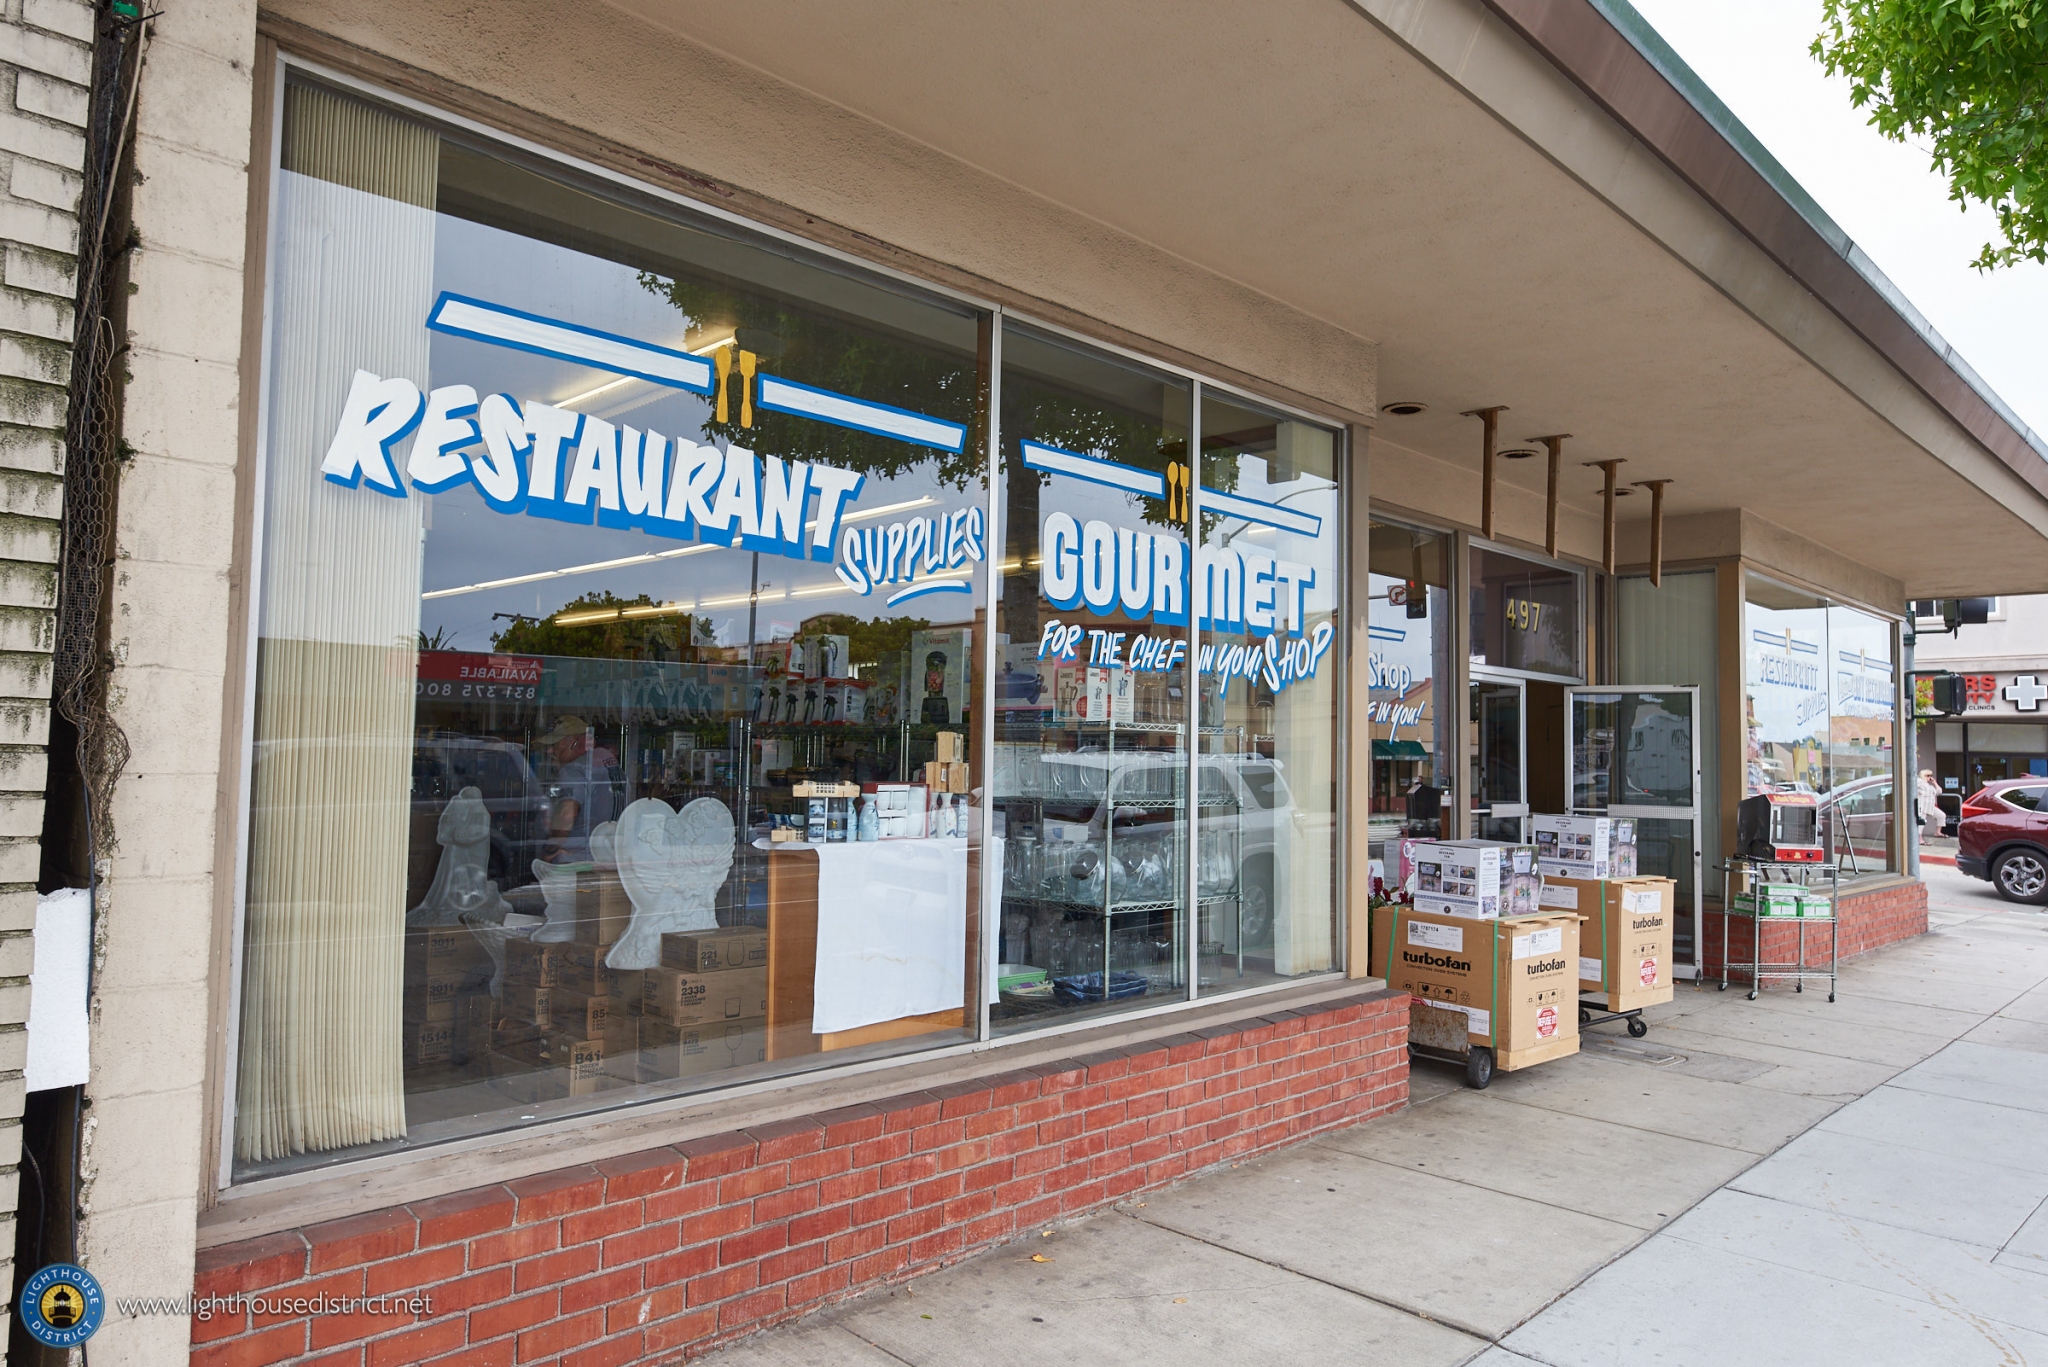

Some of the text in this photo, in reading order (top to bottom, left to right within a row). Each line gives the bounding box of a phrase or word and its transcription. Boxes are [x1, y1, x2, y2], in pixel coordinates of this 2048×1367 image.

[321, 369, 865, 562] RESTAURANT
[835, 506, 984, 596] SUPPLIES
[1043, 511, 1316, 638] GOURMET
[1507, 598, 1542, 632] 497
[1037, 620, 1085, 660] FOR
[1089, 629, 1126, 668] THE
[1129, 634, 1188, 672] CHEF
[1198, 644, 1217, 673] IN
[1262, 621, 1335, 694] SHOP
[1633, 917, 1663, 930] turbofan
[430, 936, 456, 948] 3011
[1403, 951, 1471, 971] turbofan
[1406, 963, 1433, 972] CONVECTION
[1527, 959, 1566, 975] turbofan
[681, 985, 706, 996] 2338
